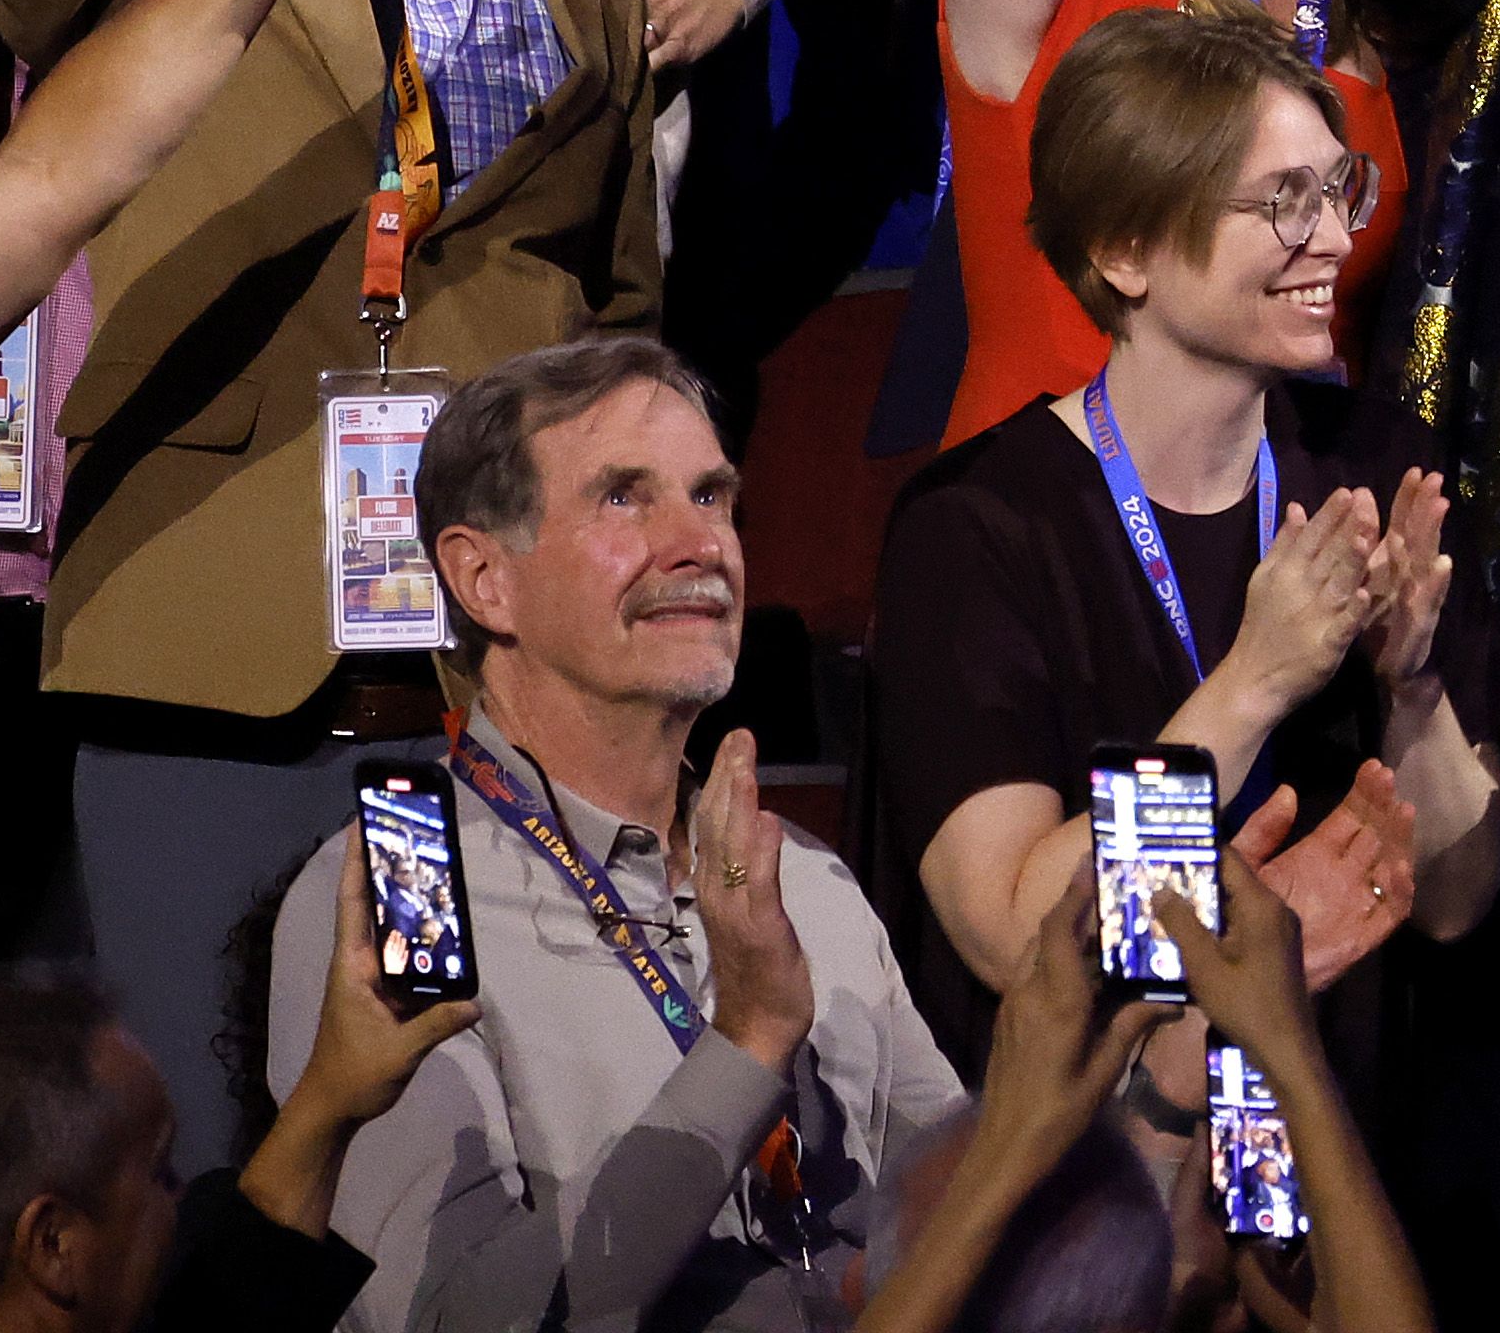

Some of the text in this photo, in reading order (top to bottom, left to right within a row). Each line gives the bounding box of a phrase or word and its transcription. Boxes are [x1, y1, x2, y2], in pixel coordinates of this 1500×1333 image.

[376, 212, 400, 230] AZ
[1122, 494, 1189, 641] DNC 2024
